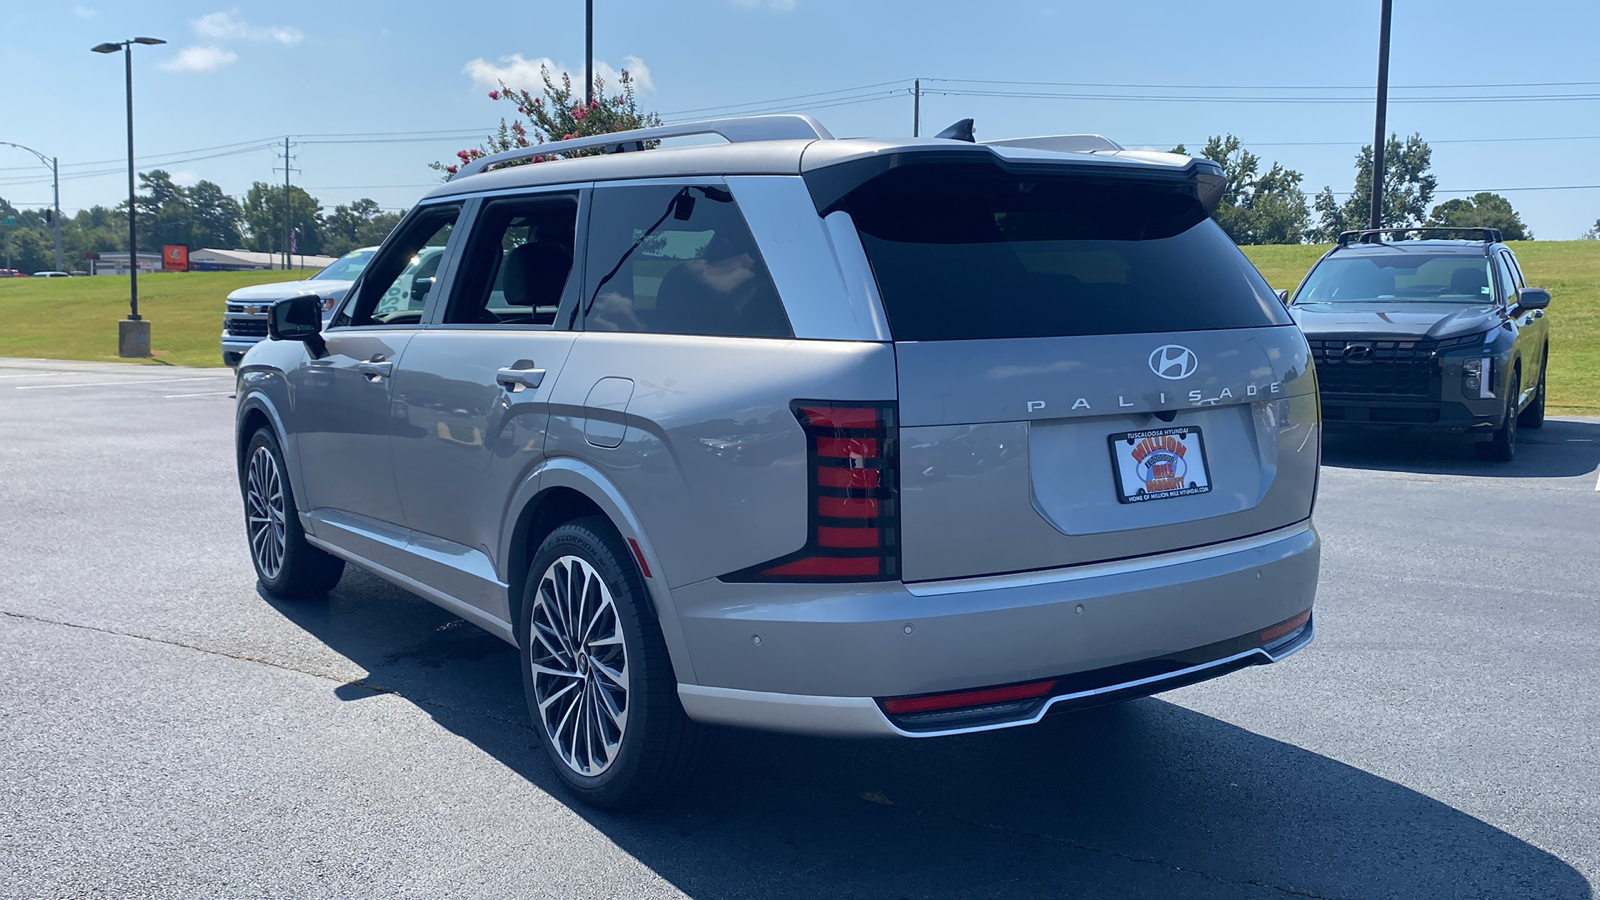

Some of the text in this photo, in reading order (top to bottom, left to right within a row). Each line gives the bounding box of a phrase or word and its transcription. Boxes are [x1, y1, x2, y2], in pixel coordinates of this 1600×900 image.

[1027, 382, 1281, 413] PALISADE
[1127, 431, 1163, 439] TUSCALOOSA
[1131, 435, 1187, 464] MILLION
[1151, 491, 1169, 499] MILLION
[1180, 487, 1209, 495] HYUNDAI.COM
[556, 535, 598, 557] SCORPION
